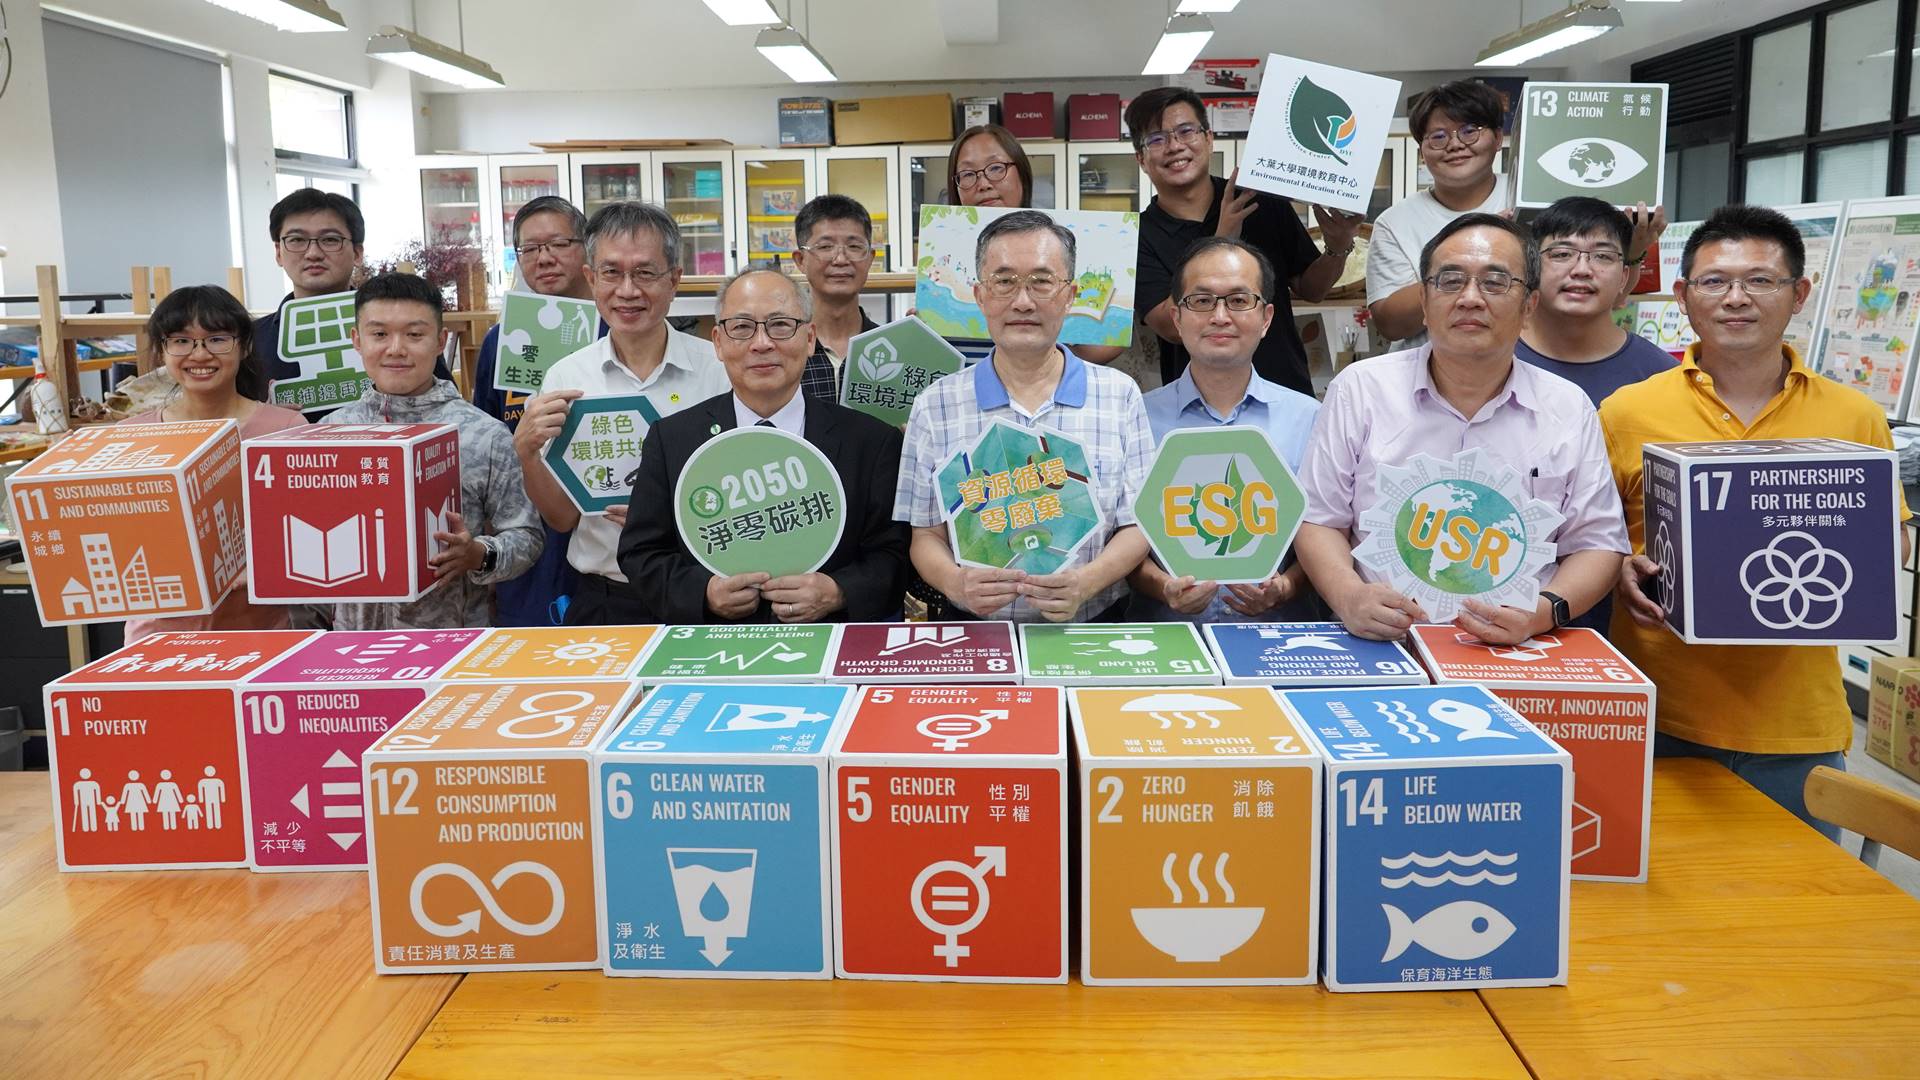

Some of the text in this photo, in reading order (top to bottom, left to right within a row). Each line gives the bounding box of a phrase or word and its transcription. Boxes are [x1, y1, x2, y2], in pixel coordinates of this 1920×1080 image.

[1530, 90, 1558, 117] 13
[1568, 91, 1609, 103] CLIMATE
[1566, 106, 1603, 118] ACTION
[1622, 106, 1650, 117] 行動
[1256, 156, 1358, 188] 大葉大學環境教育中心
[1250, 169, 1360, 200] Environmental Education Center
[522, 344, 539, 363] 零
[505, 365, 543, 387] 生活
[75, 429, 107, 440] 11
[591, 414, 634, 436] 綠色
[571, 437, 644, 461] 環境共
[286, 453, 338, 469] QUALITY
[360, 456, 390, 470] 優質
[416, 450, 423, 484] 4
[254, 454, 275, 489] 4
[360, 472, 390, 486] 教育
[1750, 467, 1865, 486] PARTNERSHIPS
[54, 480, 173, 500] SUSTAINABLE CITIES
[187, 469, 201, 505] 11
[288, 474, 358, 489] EDUCATION
[721, 456, 808, 510] 2050
[958, 456, 1069, 507] 資源循環
[1693, 471, 1733, 511] 17
[15, 489, 49, 521] 11
[59, 499, 170, 519] AND COMMUNITIES
[1162, 481, 1278, 537] ESG
[1751, 492, 1866, 510] FOR THE GOALS
[698, 491, 834, 555] 淨零碳排
[980, 494, 1064, 533] 零廢棄
[1762, 514, 1847, 528] 多元夥伴關係
[1408, 502, 1510, 576] USR
[142, 634, 168, 646] 1
[671, 628, 695, 639] 3
[391, 666, 435, 680] 10
[986, 658, 1008, 672] 8
[1168, 659, 1210, 673] 15
[1375, 661, 1418, 675] 16
[1606, 667, 1633, 681] 9
[1443, 670, 1525, 680] INNOVATION
[1875, 676, 1904, 696] NANPO
[82, 697, 102, 713] NO
[297, 693, 360, 710] REDUCED
[870, 689, 894, 704] 5
[53, 698, 70, 736] 1
[245, 695, 286, 735] 10
[1561, 699, 1647, 717] INNOVATION
[84, 719, 148, 736] POVERTY
[299, 716, 389, 735] INEQUALITIES
[1537, 722, 1645, 742] RASTRUCTURE
[617, 740, 667, 751] 6
[1182, 737, 1252, 745] HUNGER
[1214, 746, 1257, 754] ZERO
[1268, 735, 1301, 753] 2
[1332, 741, 1389, 760] 14
[435, 765, 546, 785] RESPONSIBLE
[650, 773, 765, 793] CLEAN WATER
[371, 767, 420, 816] 12
[890, 777, 956, 796] GENDER
[989, 784, 1030, 801] 性別
[1142, 776, 1186, 794] ZERO
[1233, 780, 1274, 797] 消除
[1404, 776, 1437, 796] LIFE
[436, 793, 557, 814] CONSUMPTION
[606, 772, 634, 820] 6
[847, 776, 873, 823] 5
[1097, 776, 1124, 823] 2
[1339, 777, 1388, 826] 14
[651, 801, 791, 822] AND SANITATION
[891, 804, 970, 826] EQUALITY
[989, 805, 1030, 823] 平權
[1142, 804, 1214, 823] HUNGER
[1233, 801, 1274, 818] 飢餓
[1404, 802, 1522, 825] BELOW WATER
[263, 822, 302, 836] 減少
[438, 821, 584, 843] AND PRODUCTION
[260, 839, 307, 853] 不平等
[616, 922, 661, 939] 淨水
[388, 943, 516, 962] 責任消費及生產
[613, 943, 666, 960] 及衛生
[1400, 966, 1493, 982] 保育海洋生態
